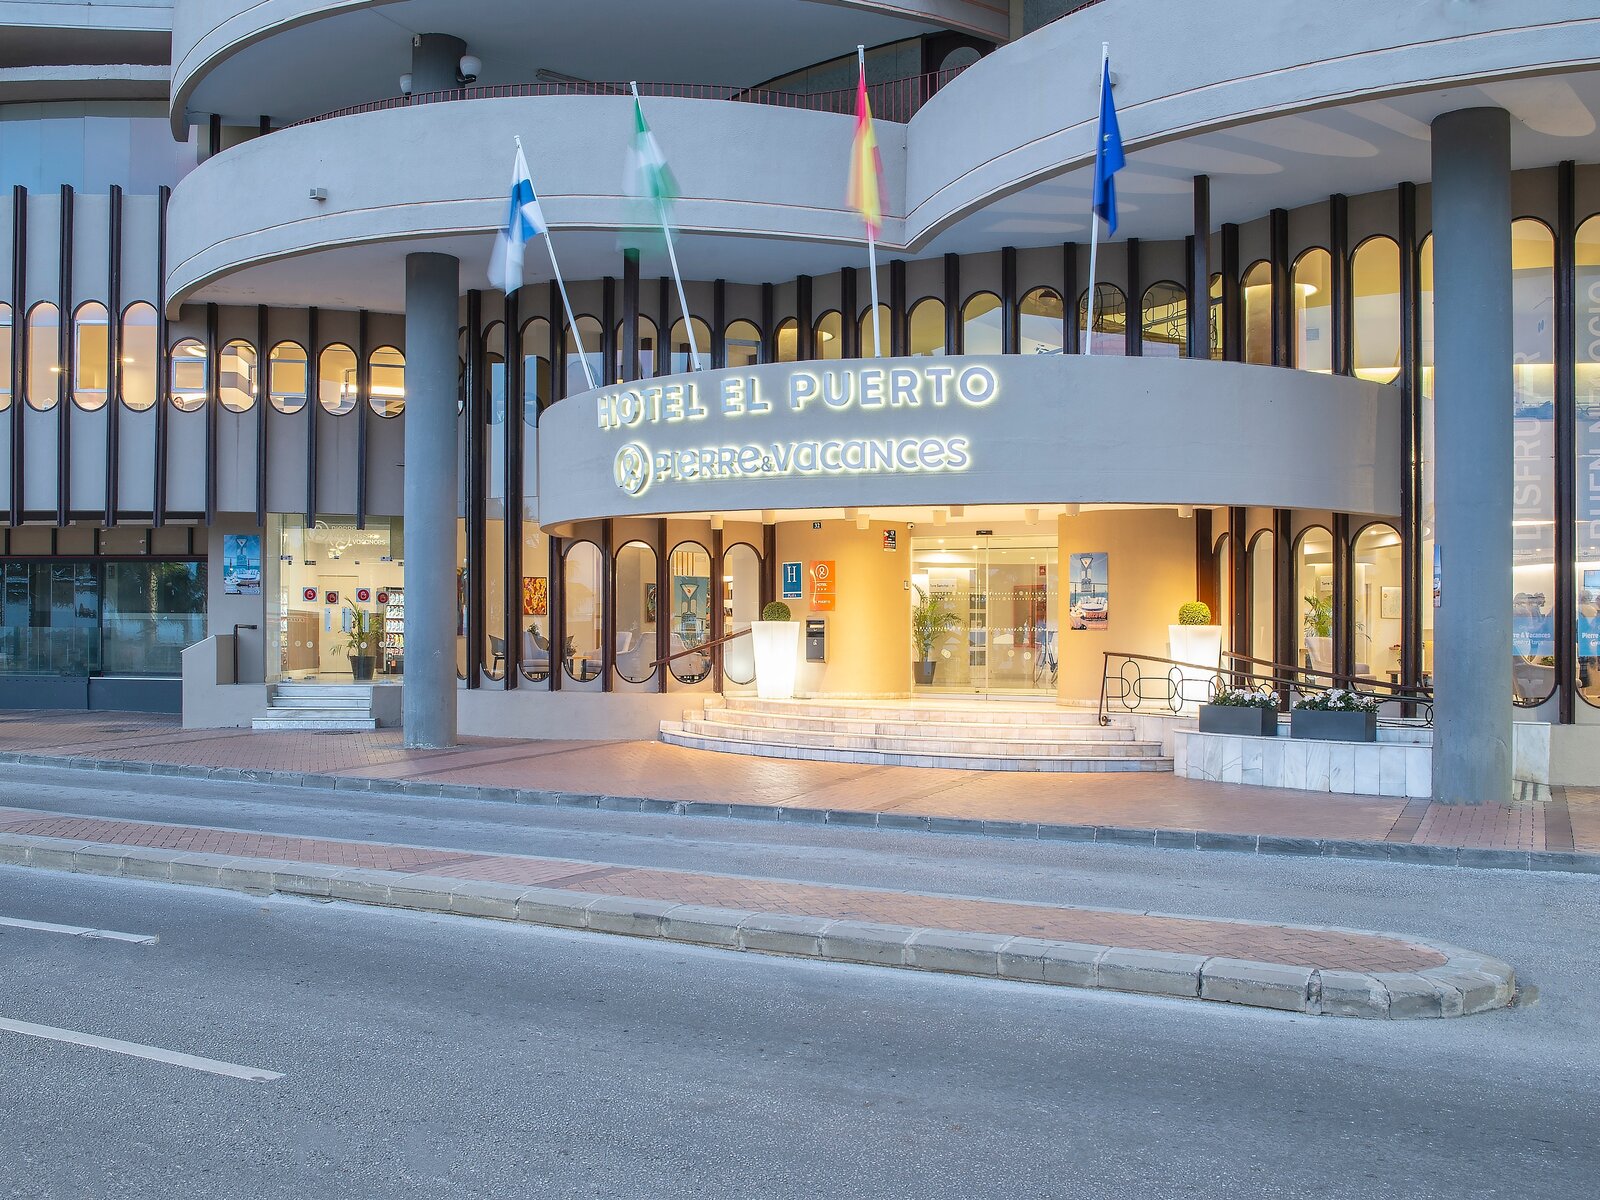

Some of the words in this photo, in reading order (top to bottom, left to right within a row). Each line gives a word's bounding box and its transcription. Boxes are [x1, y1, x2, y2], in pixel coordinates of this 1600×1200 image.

[597, 384, 704, 428] HOTEL
[720, 377, 768, 412] EL
[790, 367, 995, 407] PUERTO
